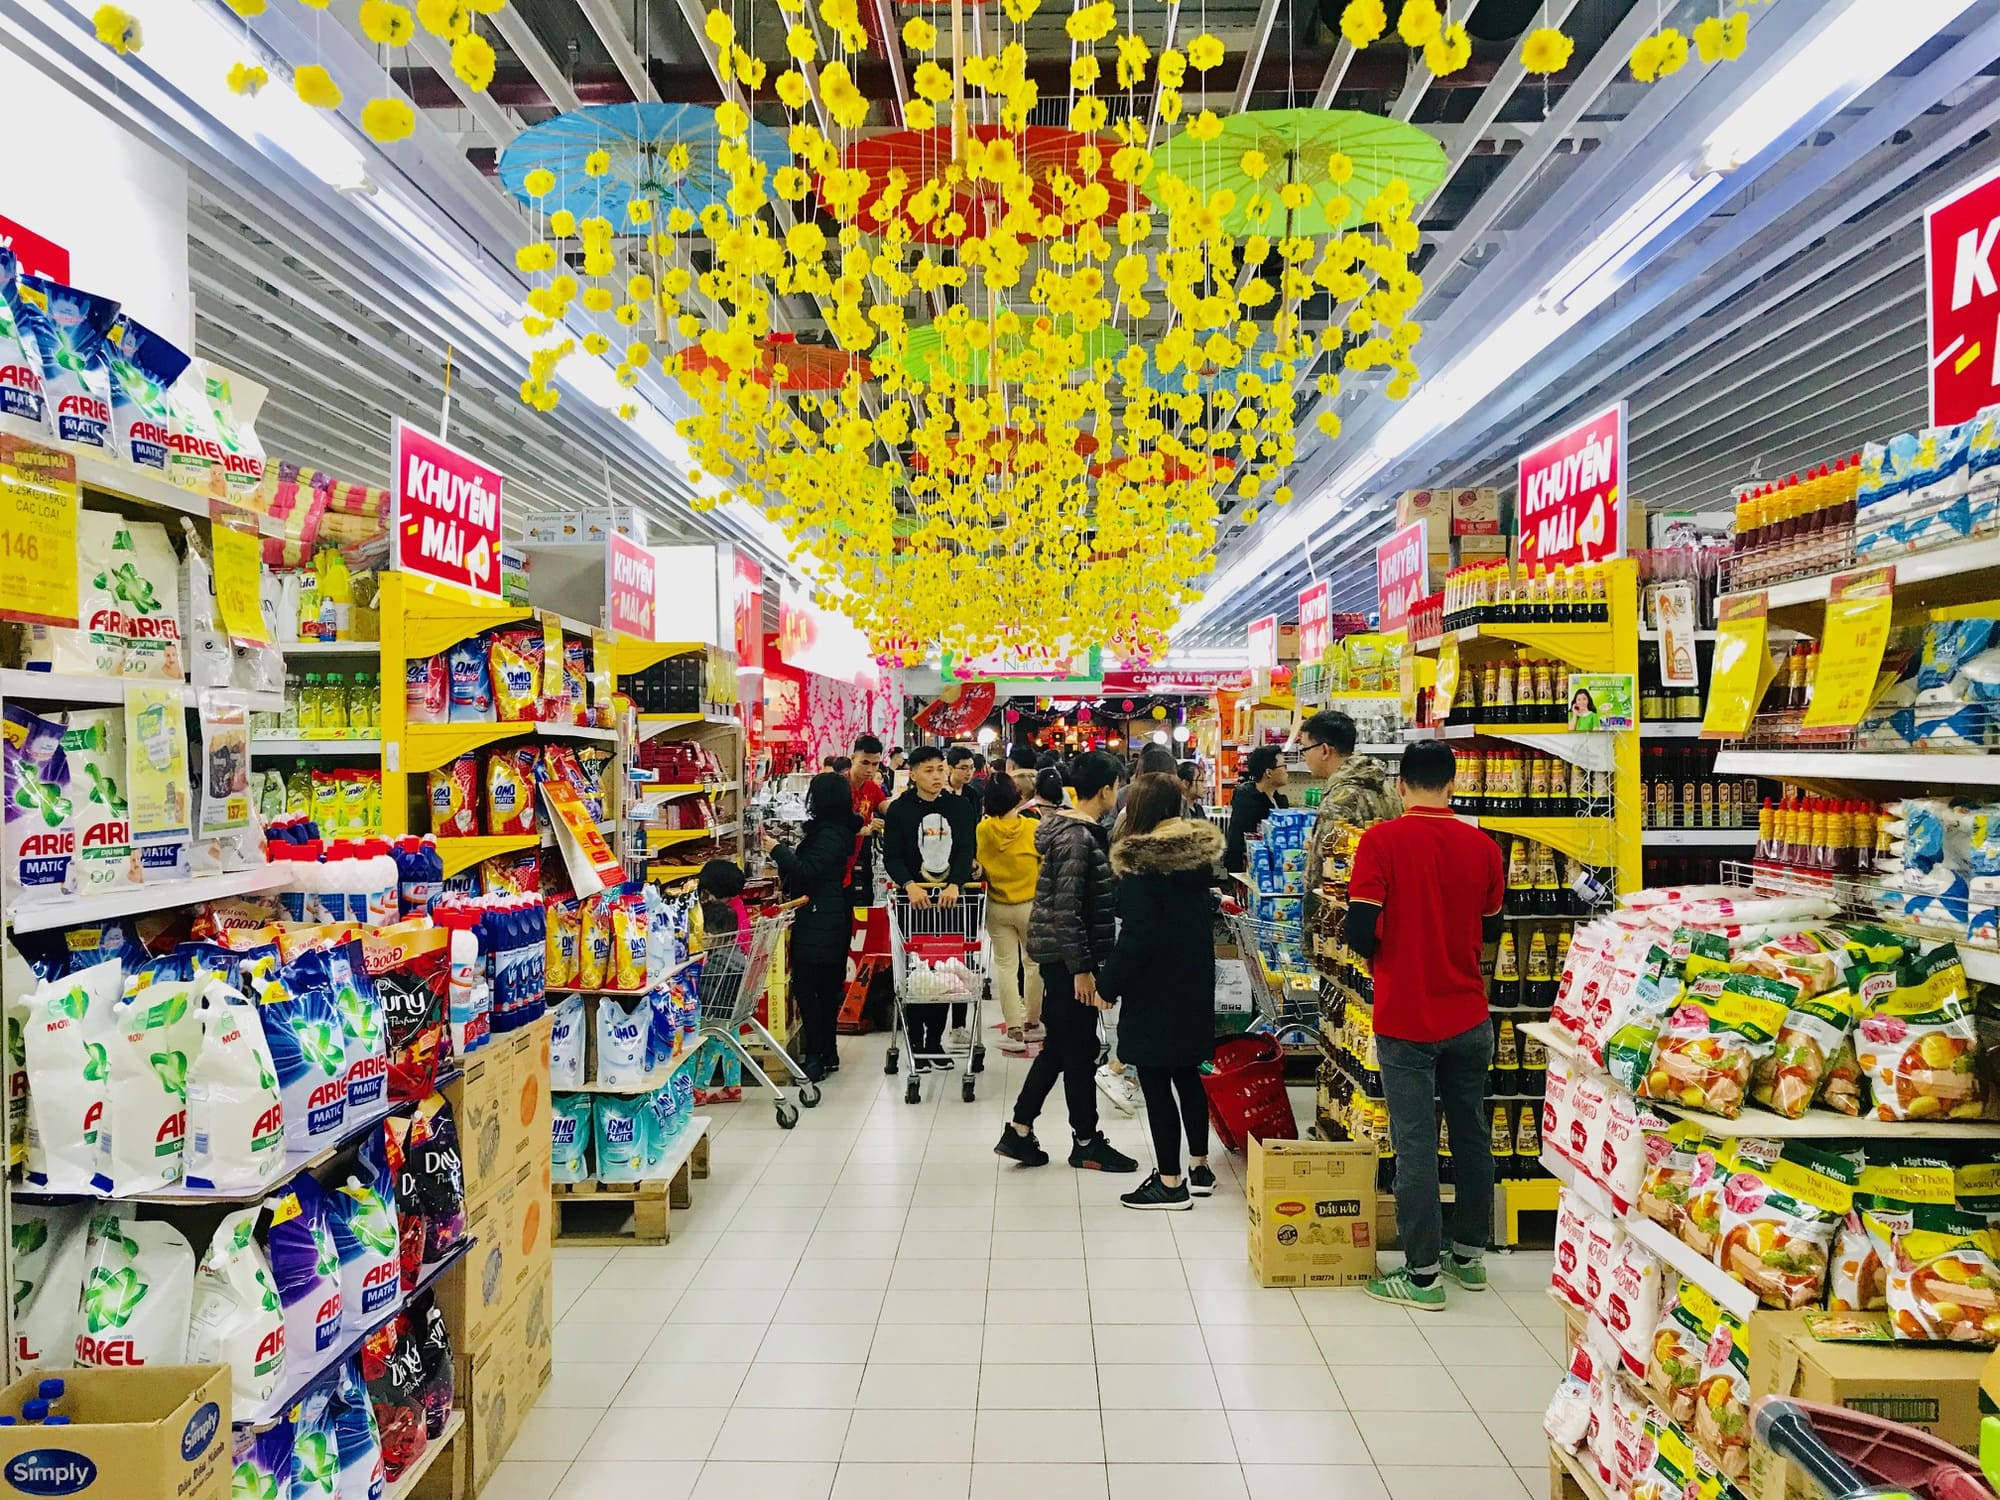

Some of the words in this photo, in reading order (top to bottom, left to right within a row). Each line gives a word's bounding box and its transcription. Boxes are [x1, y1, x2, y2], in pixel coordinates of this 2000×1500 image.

[58, 395, 111, 422] ARIE
[130, 422, 167, 445] ARIE
[1526, 432, 1613, 516] KHUYẾN
[407, 454, 496, 531] KHUYẾN
[1, 529, 39, 561] 146
[614, 552, 653, 595] KHUYẾN
[1381, 537, 1419, 588] KHUYẾN
[506, 672, 531, 682] OMO
[495, 784, 515, 796] OMO
[19, 833, 74, 857] ARIE
[26, 860, 64, 874] MATIC
[552, 1025, 570, 1041] MO
[614, 1024, 638, 1041] OMO
[350, 1054, 386, 1081] ARIE
[307, 1077, 347, 1109] ARIE
[353, 1079, 379, 1096] MATIC
[314, 1106, 342, 1124] MATIC
[367, 1281, 395, 1302] MATIC
[185, 1412, 217, 1452] Simply
[13, 1456, 90, 1488] Simply
